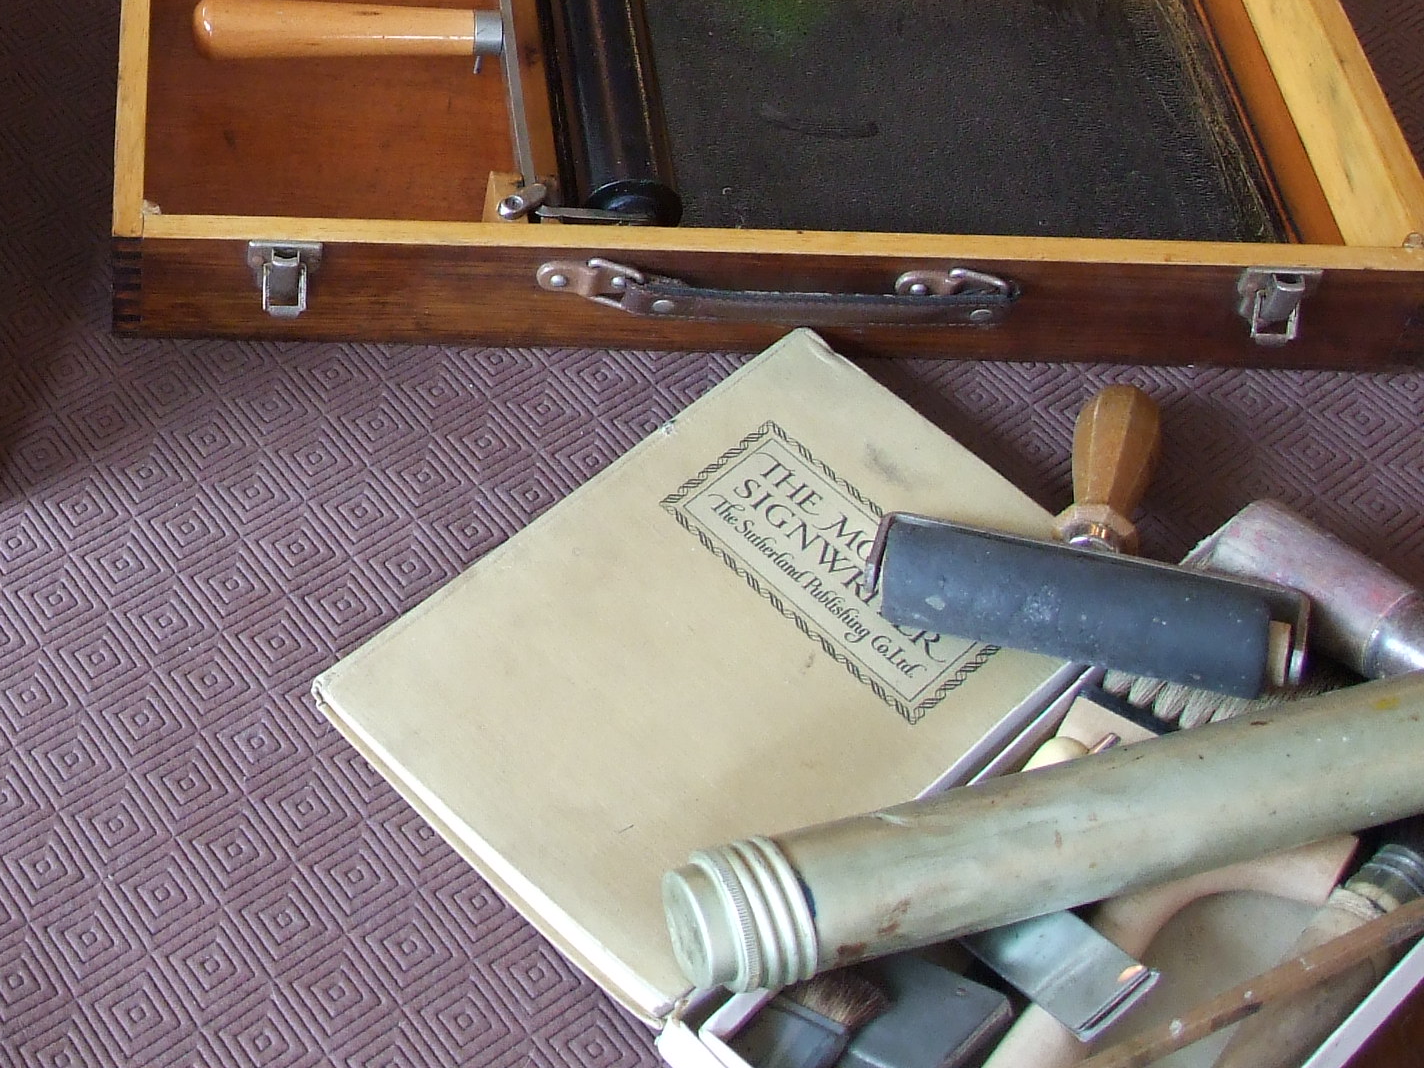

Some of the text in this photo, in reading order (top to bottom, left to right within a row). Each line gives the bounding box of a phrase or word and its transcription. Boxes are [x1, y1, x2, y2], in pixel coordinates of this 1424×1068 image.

[756, 452, 824, 515] THE
[708, 493, 745, 525] The
[734, 517, 812, 582] Sutherland
[802, 573, 871, 643] Publishing
